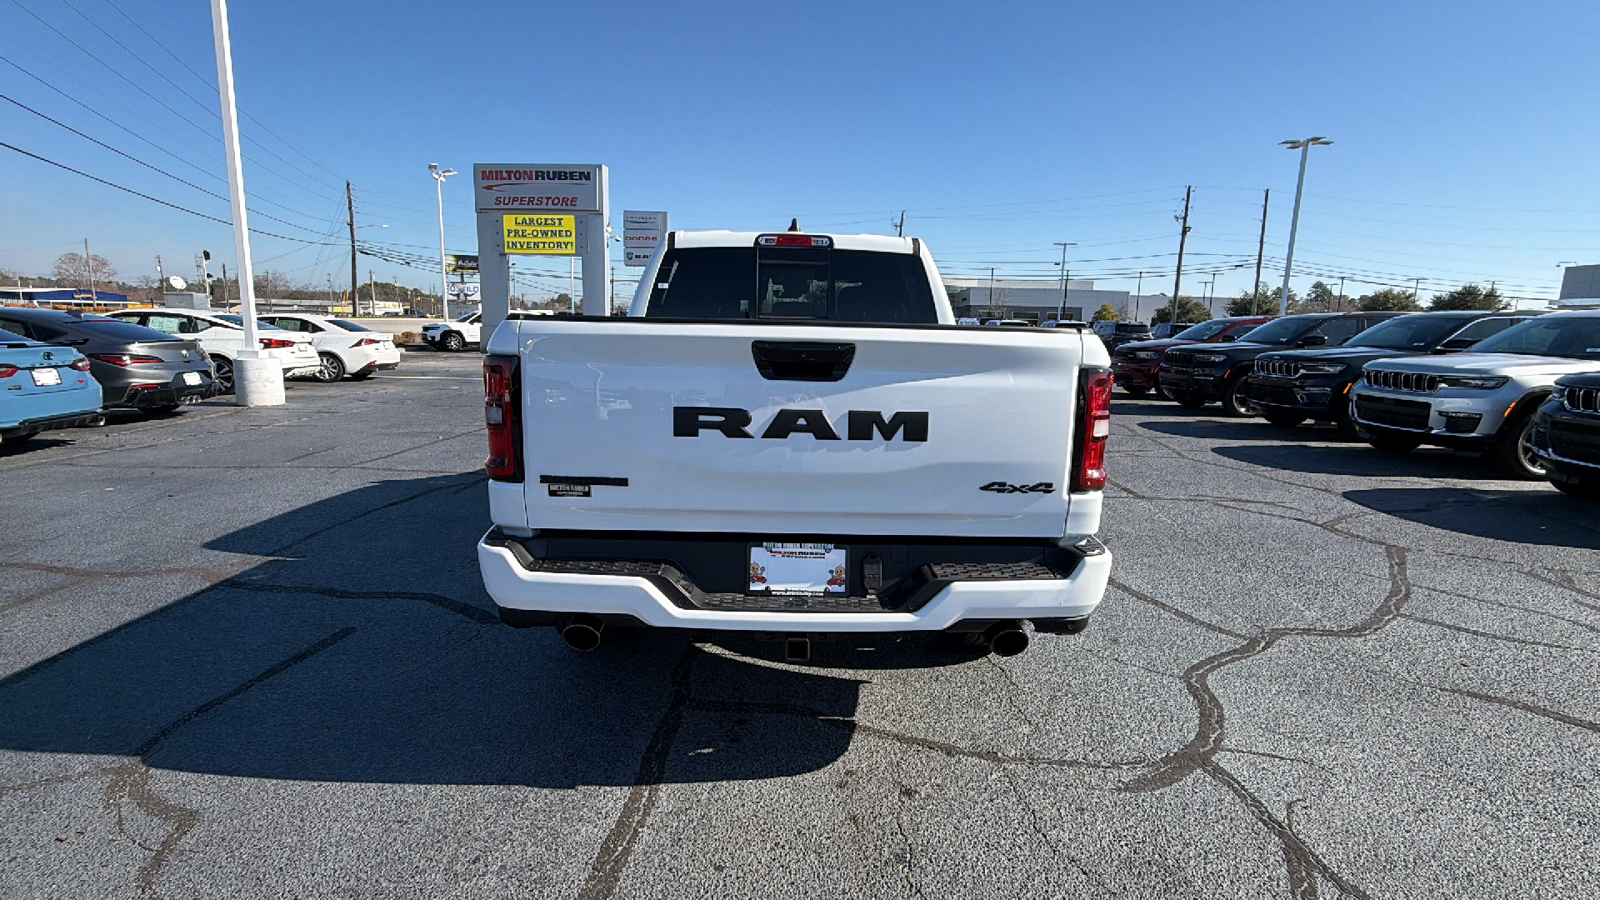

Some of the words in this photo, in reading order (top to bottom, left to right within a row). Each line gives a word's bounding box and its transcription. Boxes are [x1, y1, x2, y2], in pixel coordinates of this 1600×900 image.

[494, 196, 579, 207] SUPERSTORE
[514, 216, 564, 226] LARGEST
[506, 228, 573, 238] PRE-OWNED
[506, 240, 574, 250] INVENTORY!
[673, 406, 930, 443] RAM
